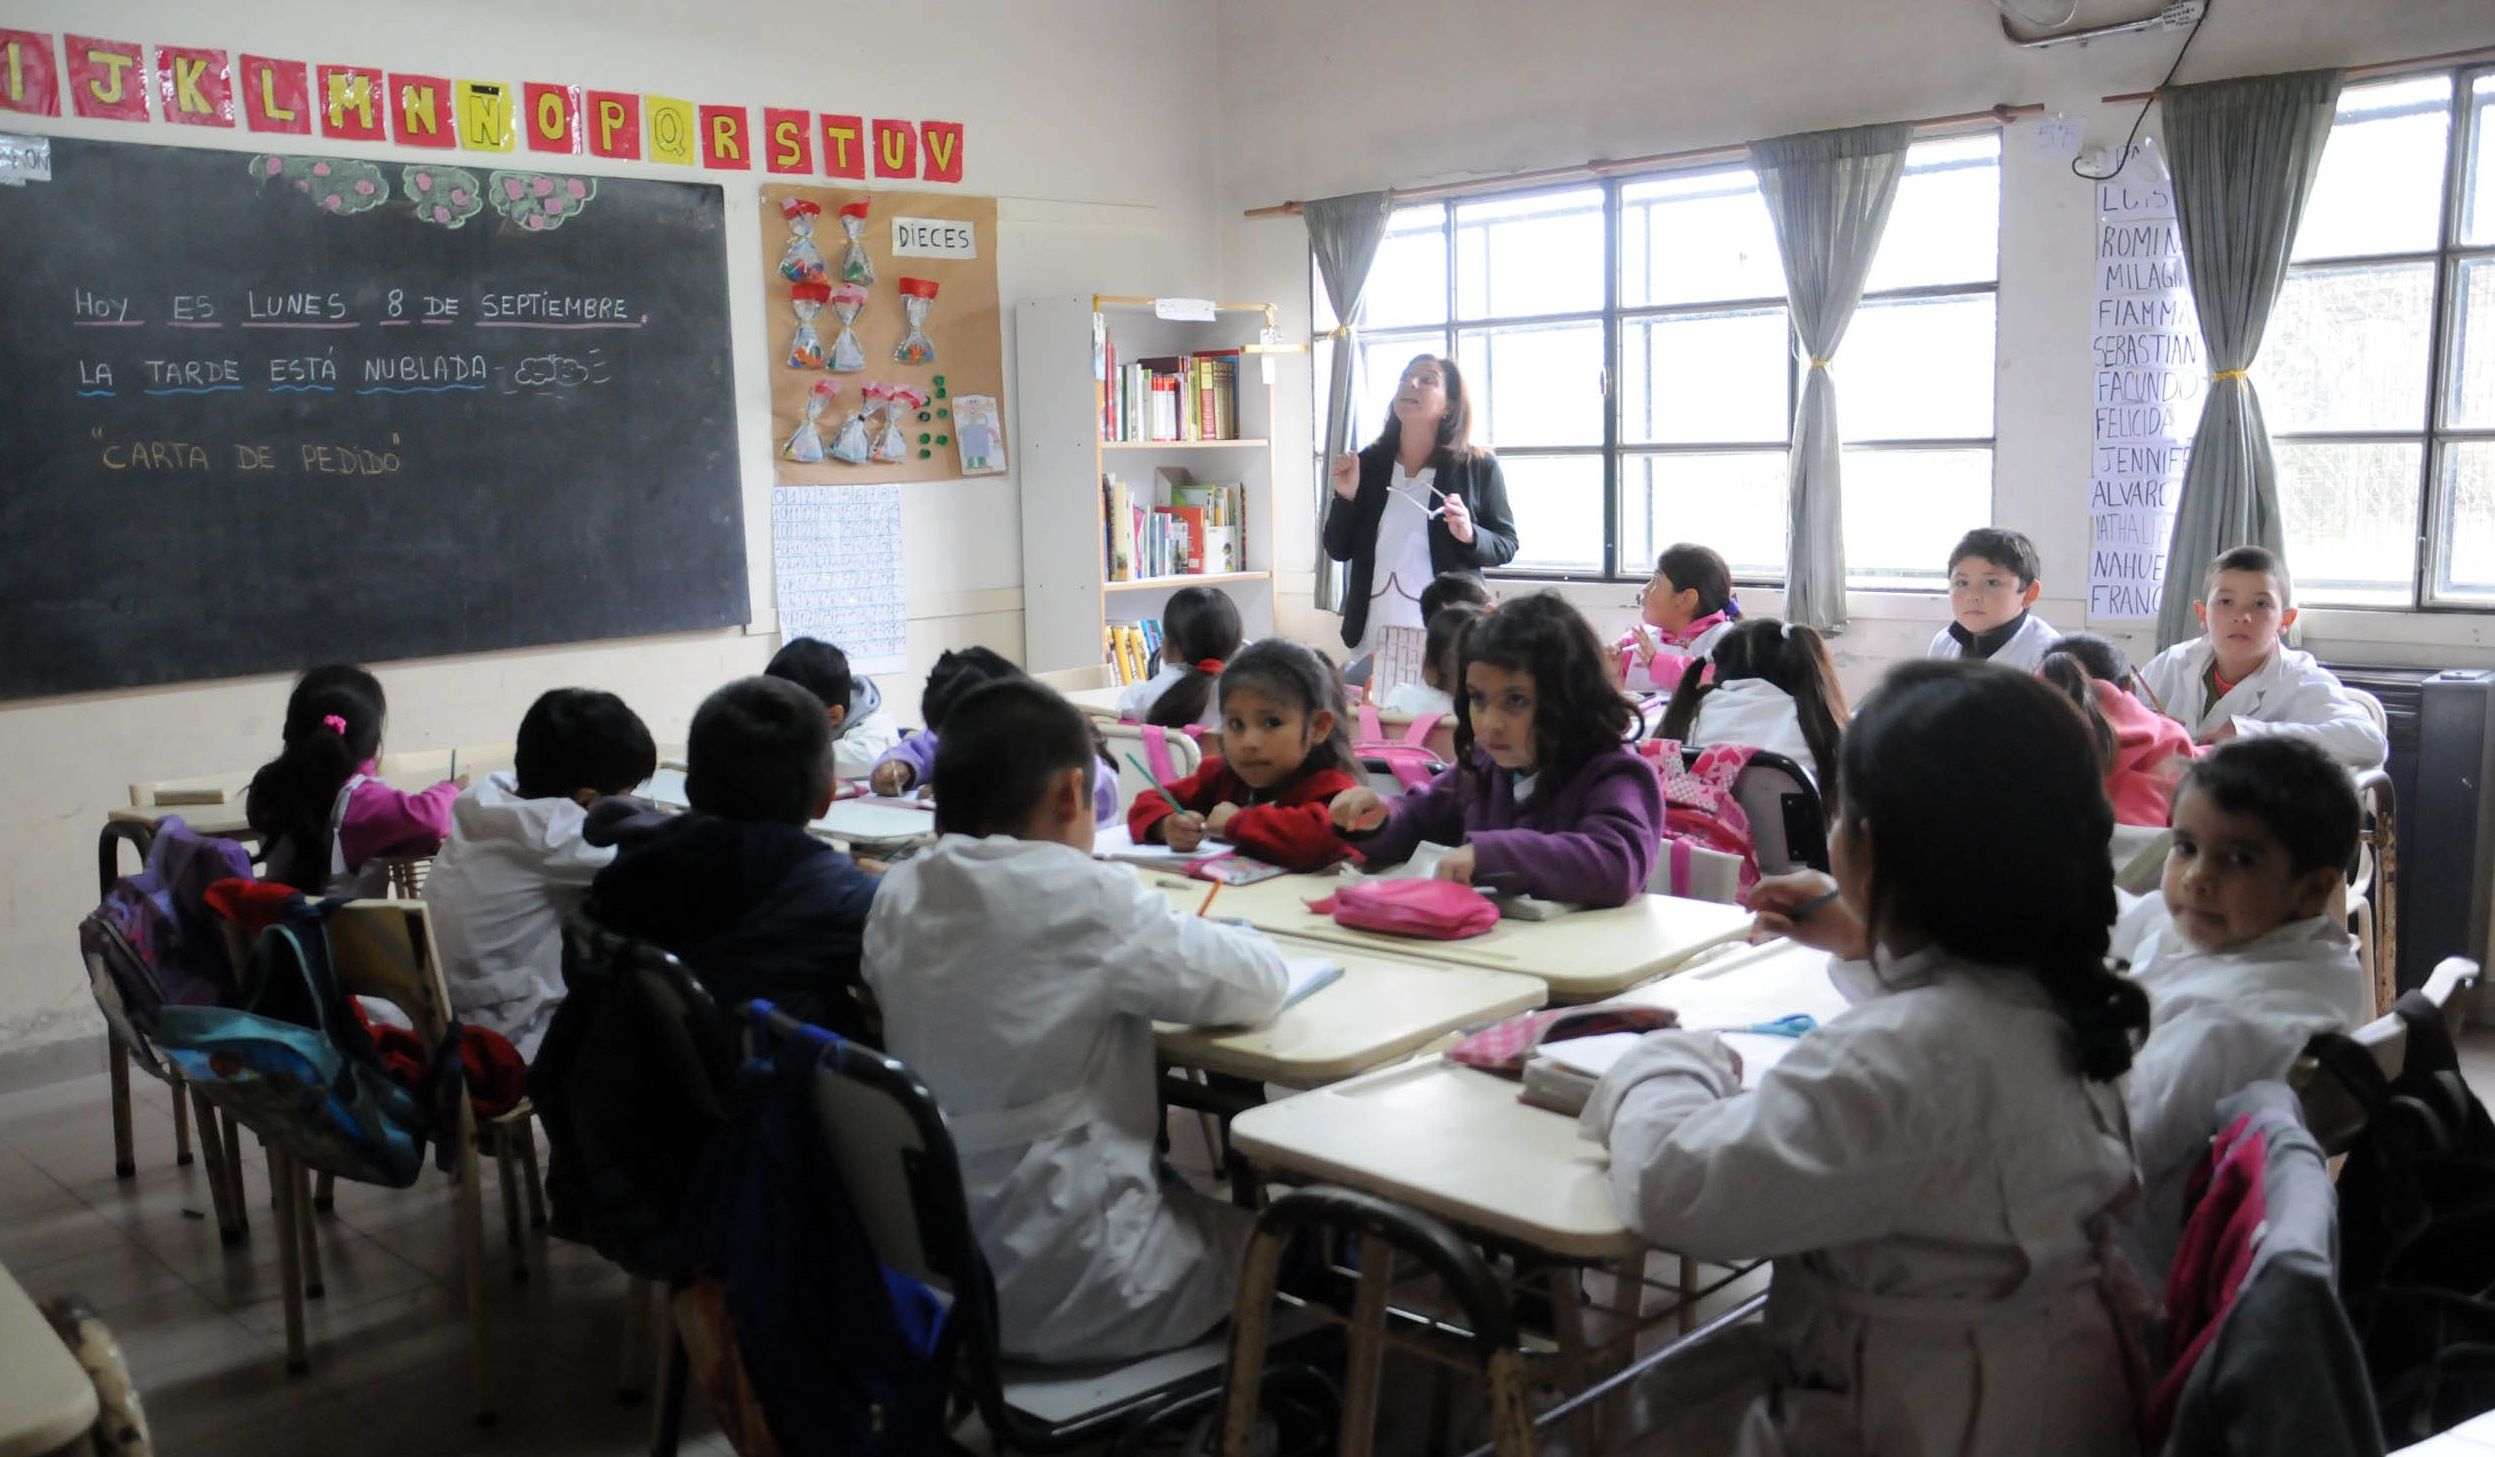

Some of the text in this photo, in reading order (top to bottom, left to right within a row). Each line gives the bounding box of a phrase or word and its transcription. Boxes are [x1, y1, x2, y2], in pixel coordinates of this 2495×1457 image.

[6, 42, 24, 101] I
[87, 50, 134, 104] J
[175, 57, 214, 115] K
[261, 68, 296, 121] L
[327, 73, 374, 129] M
[403, 85, 437, 135] N
[537, 93, 565, 141] O
[600, 100, 626, 151] P
[654, 106, 684, 156] Q
[712, 115, 740, 161] R
[775, 120, 801, 168] S
[828, 126, 855, 169] T
[882, 128, 905, 171] U
[928, 130, 955, 173] V
[173, 295, 214, 320] ES
[249, 291, 346, 319] LUNES
[388, 289, 403, 317] 8
[423, 296, 459, 316] DE
[79, 360, 113, 386] LA
[145, 360, 240, 385] TARDE
[270, 346, 337, 382] ESTÁ
[2093, 333, 2198, 368] SEBASTIAN
[2098, 371, 2199, 402] FACUNDO
[234, 444, 275, 469] DE
[2092, 479, 2174, 508] ALVARO
[2093, 551, 2166, 581] NAHUE
